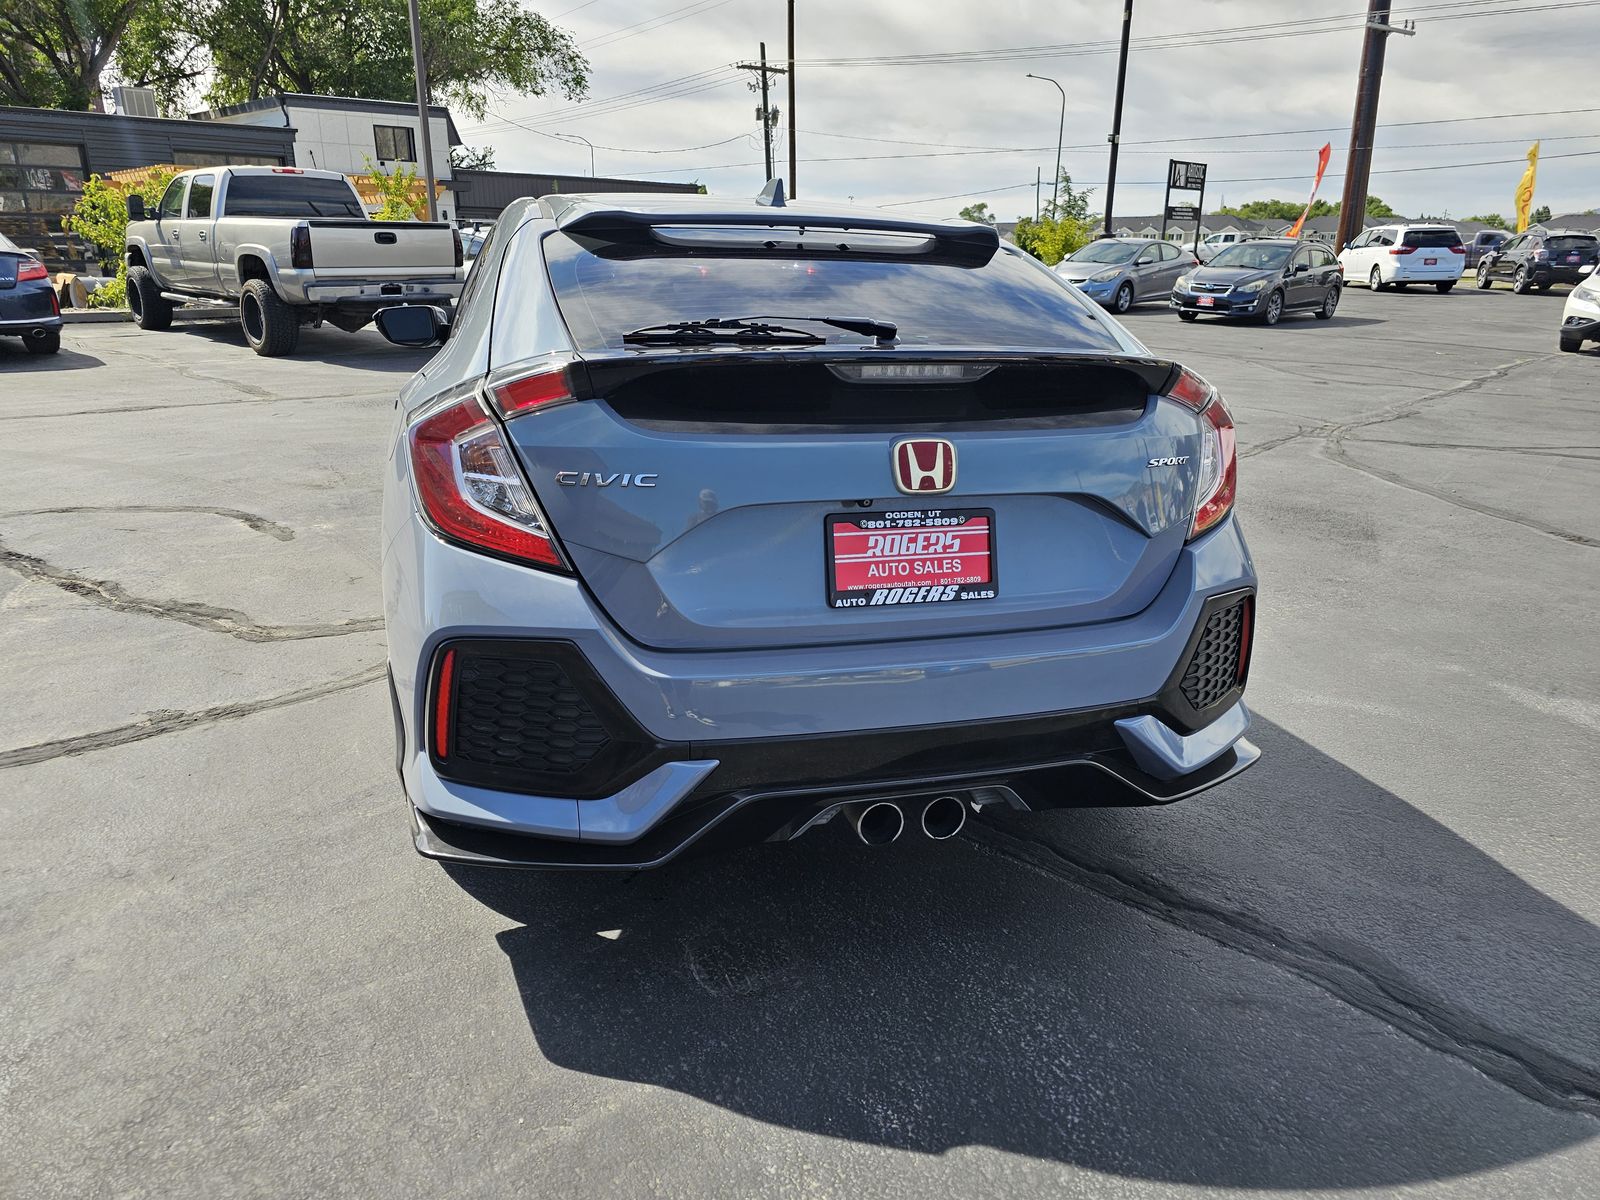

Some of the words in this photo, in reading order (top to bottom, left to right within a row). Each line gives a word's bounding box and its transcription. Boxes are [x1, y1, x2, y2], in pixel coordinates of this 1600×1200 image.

[1147, 456, 1189, 468] SPORT
[555, 471, 658, 487] CIVIC
[867, 517, 958, 528] 801-782-5809
[885, 511, 925, 519] OGDEN,
[866, 532, 961, 556] ROGERS
[868, 562, 910, 577] AUTO
[914, 559, 962, 575] SALES
[847, 580, 932, 591] www.rogersautoutah.com
[940, 576, 981, 585] 801-782-5809
[835, 598, 866, 607] AUTO
[870, 585, 959, 606] ROGERS
[961, 590, 995, 600] SALES
